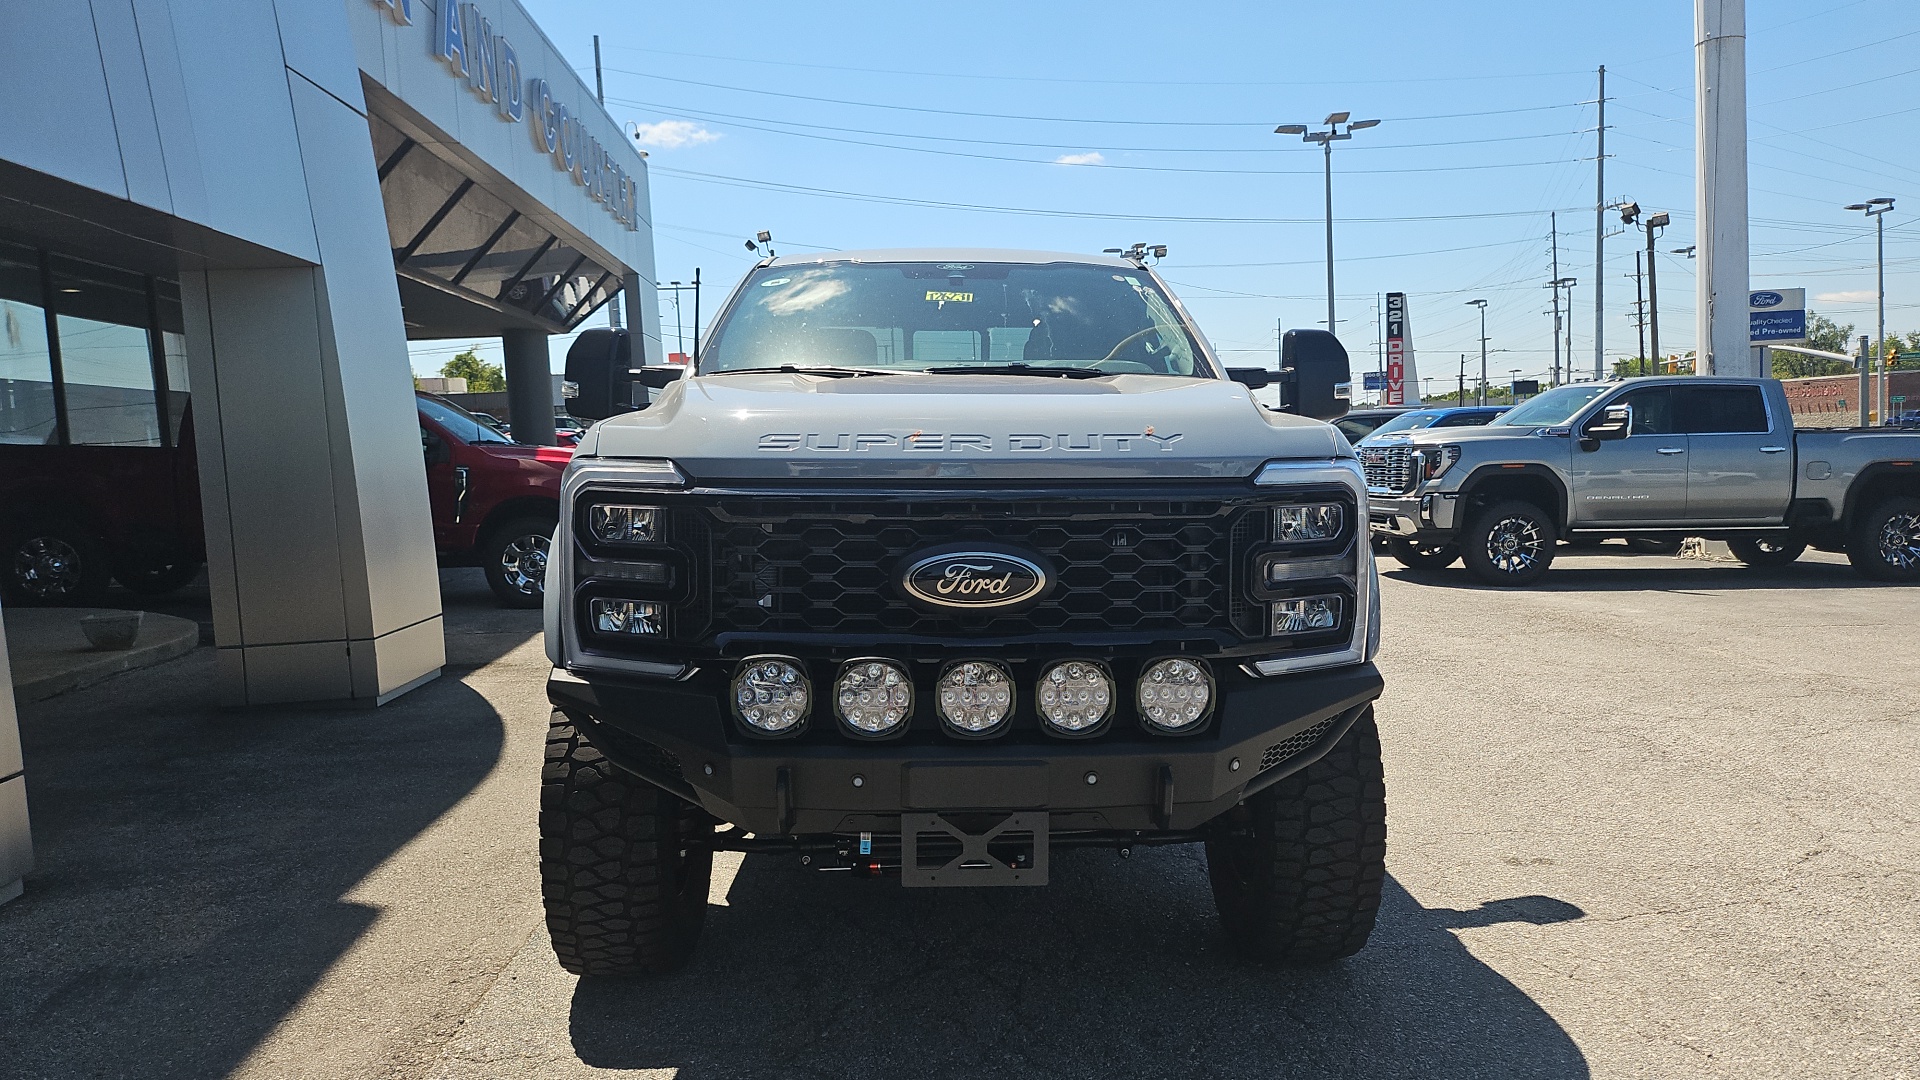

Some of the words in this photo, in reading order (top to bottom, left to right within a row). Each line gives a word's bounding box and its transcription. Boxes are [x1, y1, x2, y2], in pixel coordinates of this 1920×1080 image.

[434, 0, 523, 123] AND
[1753, 294, 1777, 305] Ford
[1388, 296, 1402, 335] 321
[1762, 327, 1801, 335] Pre-owned
[1388, 340, 1403, 403] DRIVE
[758, 433, 993, 453] SUPER
[1008, 433, 1184, 453] DUTY
[936, 563, 1012, 594] Ford
